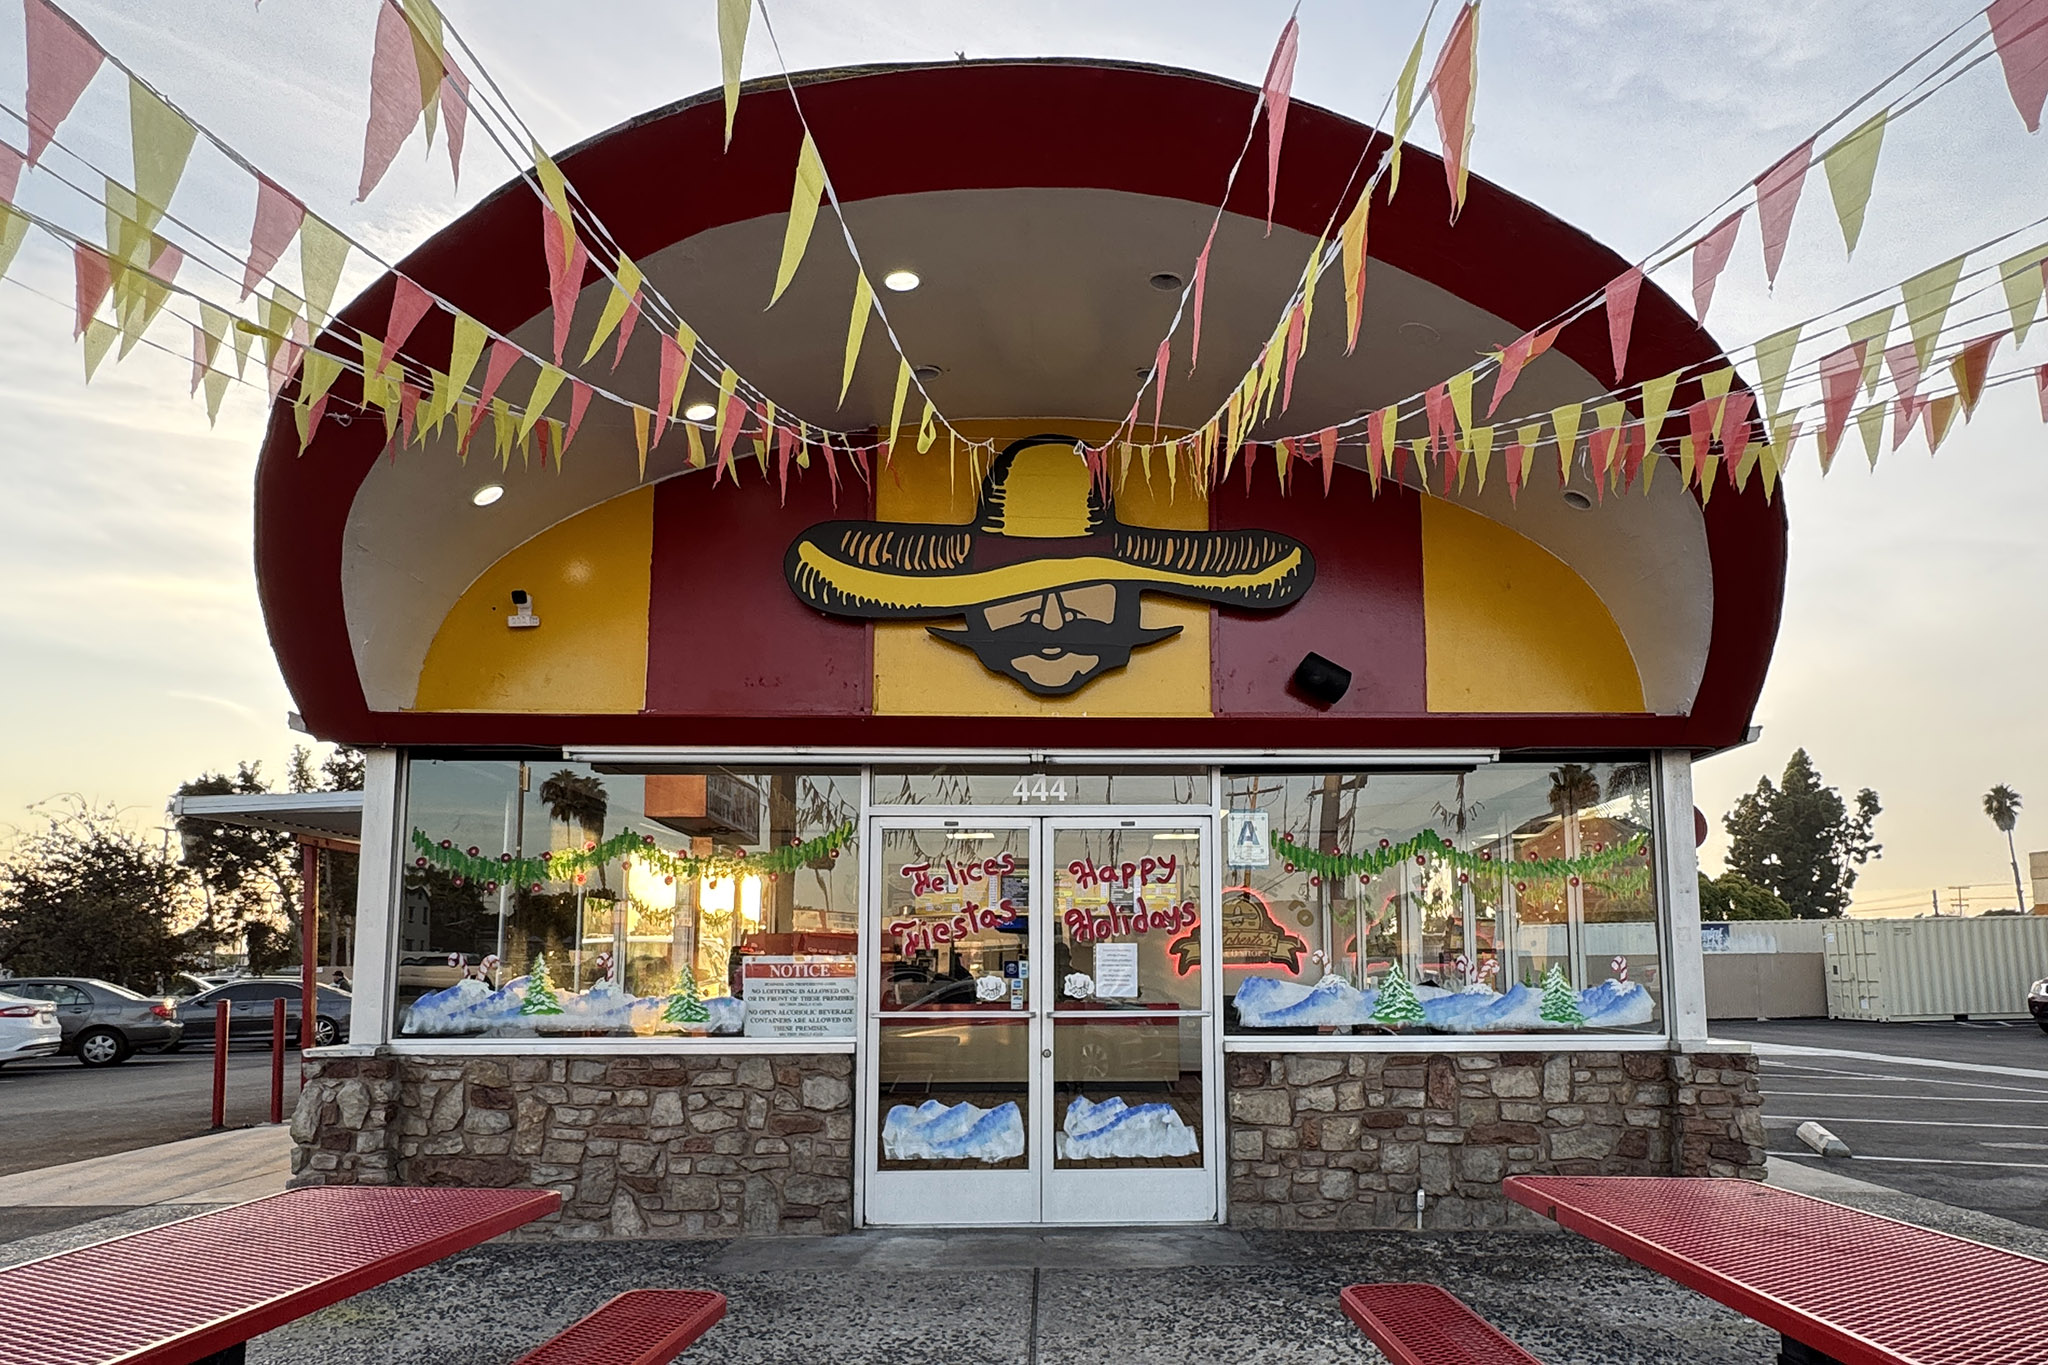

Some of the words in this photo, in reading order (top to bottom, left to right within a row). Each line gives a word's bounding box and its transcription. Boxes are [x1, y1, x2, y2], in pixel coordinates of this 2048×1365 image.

[1012, 776, 1068, 802] 444
[1237, 820, 1261, 846] A
[901, 853, 1015, 897] Felices
[1069, 854, 1177, 889] Happy
[890, 900, 1017, 956] Fiestas
[1064, 897, 1196, 941] Holidays
[769, 964, 831, 977] NOTICE
